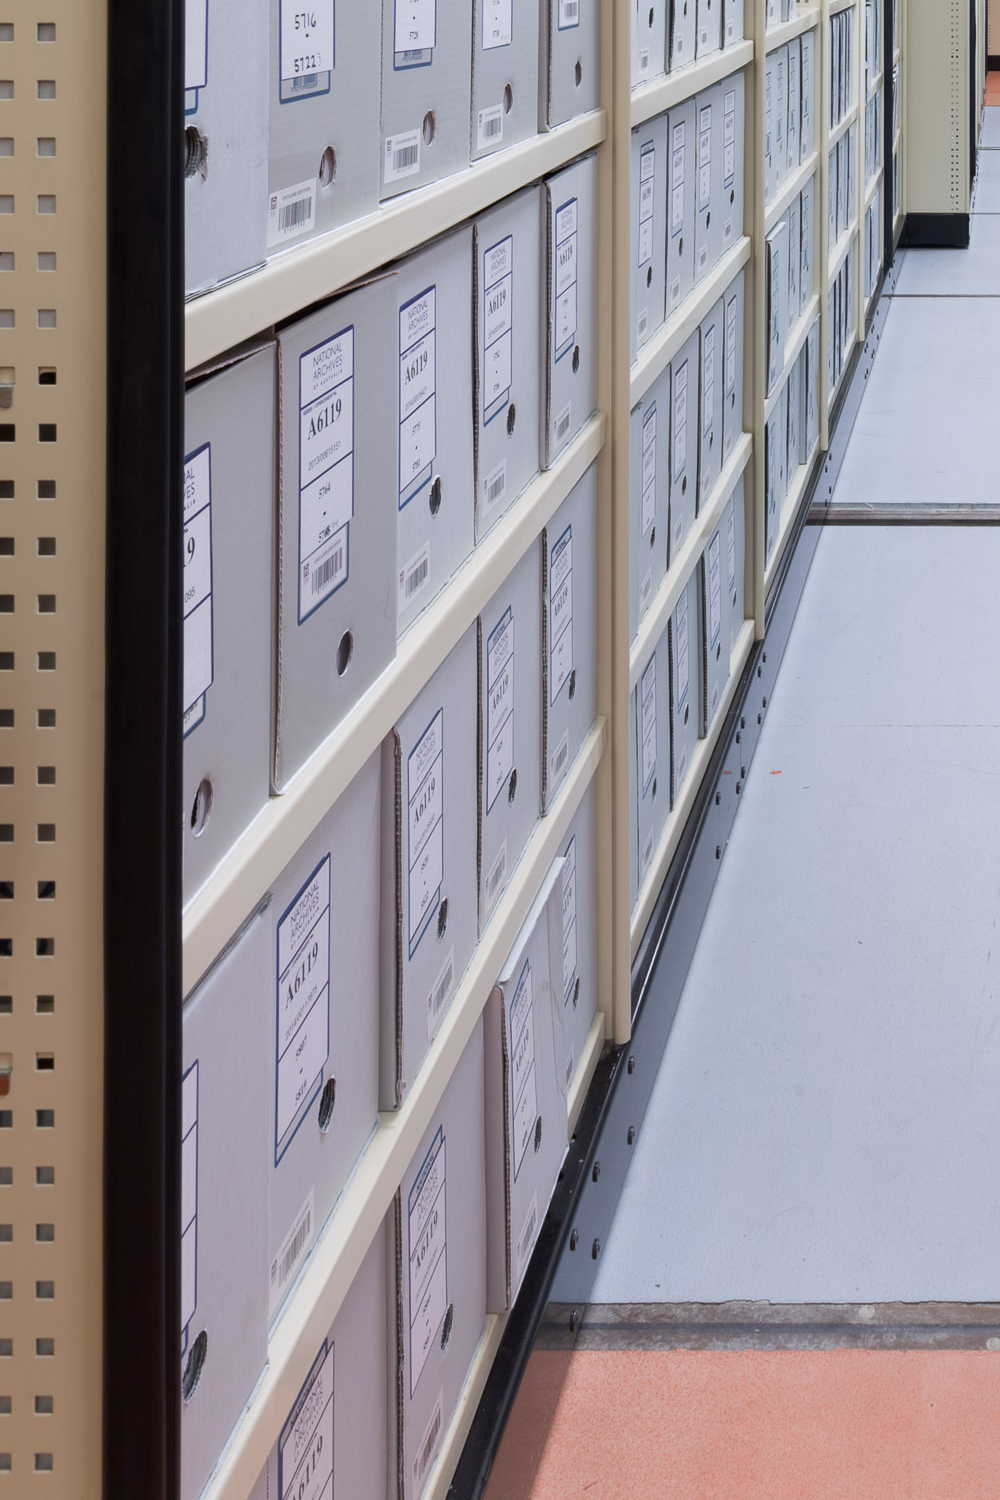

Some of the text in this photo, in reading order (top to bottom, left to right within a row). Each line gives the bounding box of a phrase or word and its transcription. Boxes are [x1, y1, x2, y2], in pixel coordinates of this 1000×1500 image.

[295, 13, 316, 30] 5716
[559, 244, 572, 268] A6119
[408, 301, 428, 320] NATIONAL
[488, 289, 506, 316] A6119
[408, 311, 428, 331] ARCHIVES
[312, 342, 342, 367] NATIONAL
[313, 355, 342, 381] ARCHIVES
[405, 351, 427, 385] A6119
[308, 398, 342, 440] A6119
[554, 587, 568, 621] A6119
[492, 674, 509, 715] A6119
[414, 778, 436, 828] A6119
[290, 880, 318, 925] NATIONAL
[290, 893, 319, 940] ARCHIVES
[285, 942, 319, 1010] A6119
[415, 1211, 438, 1278] A6119
